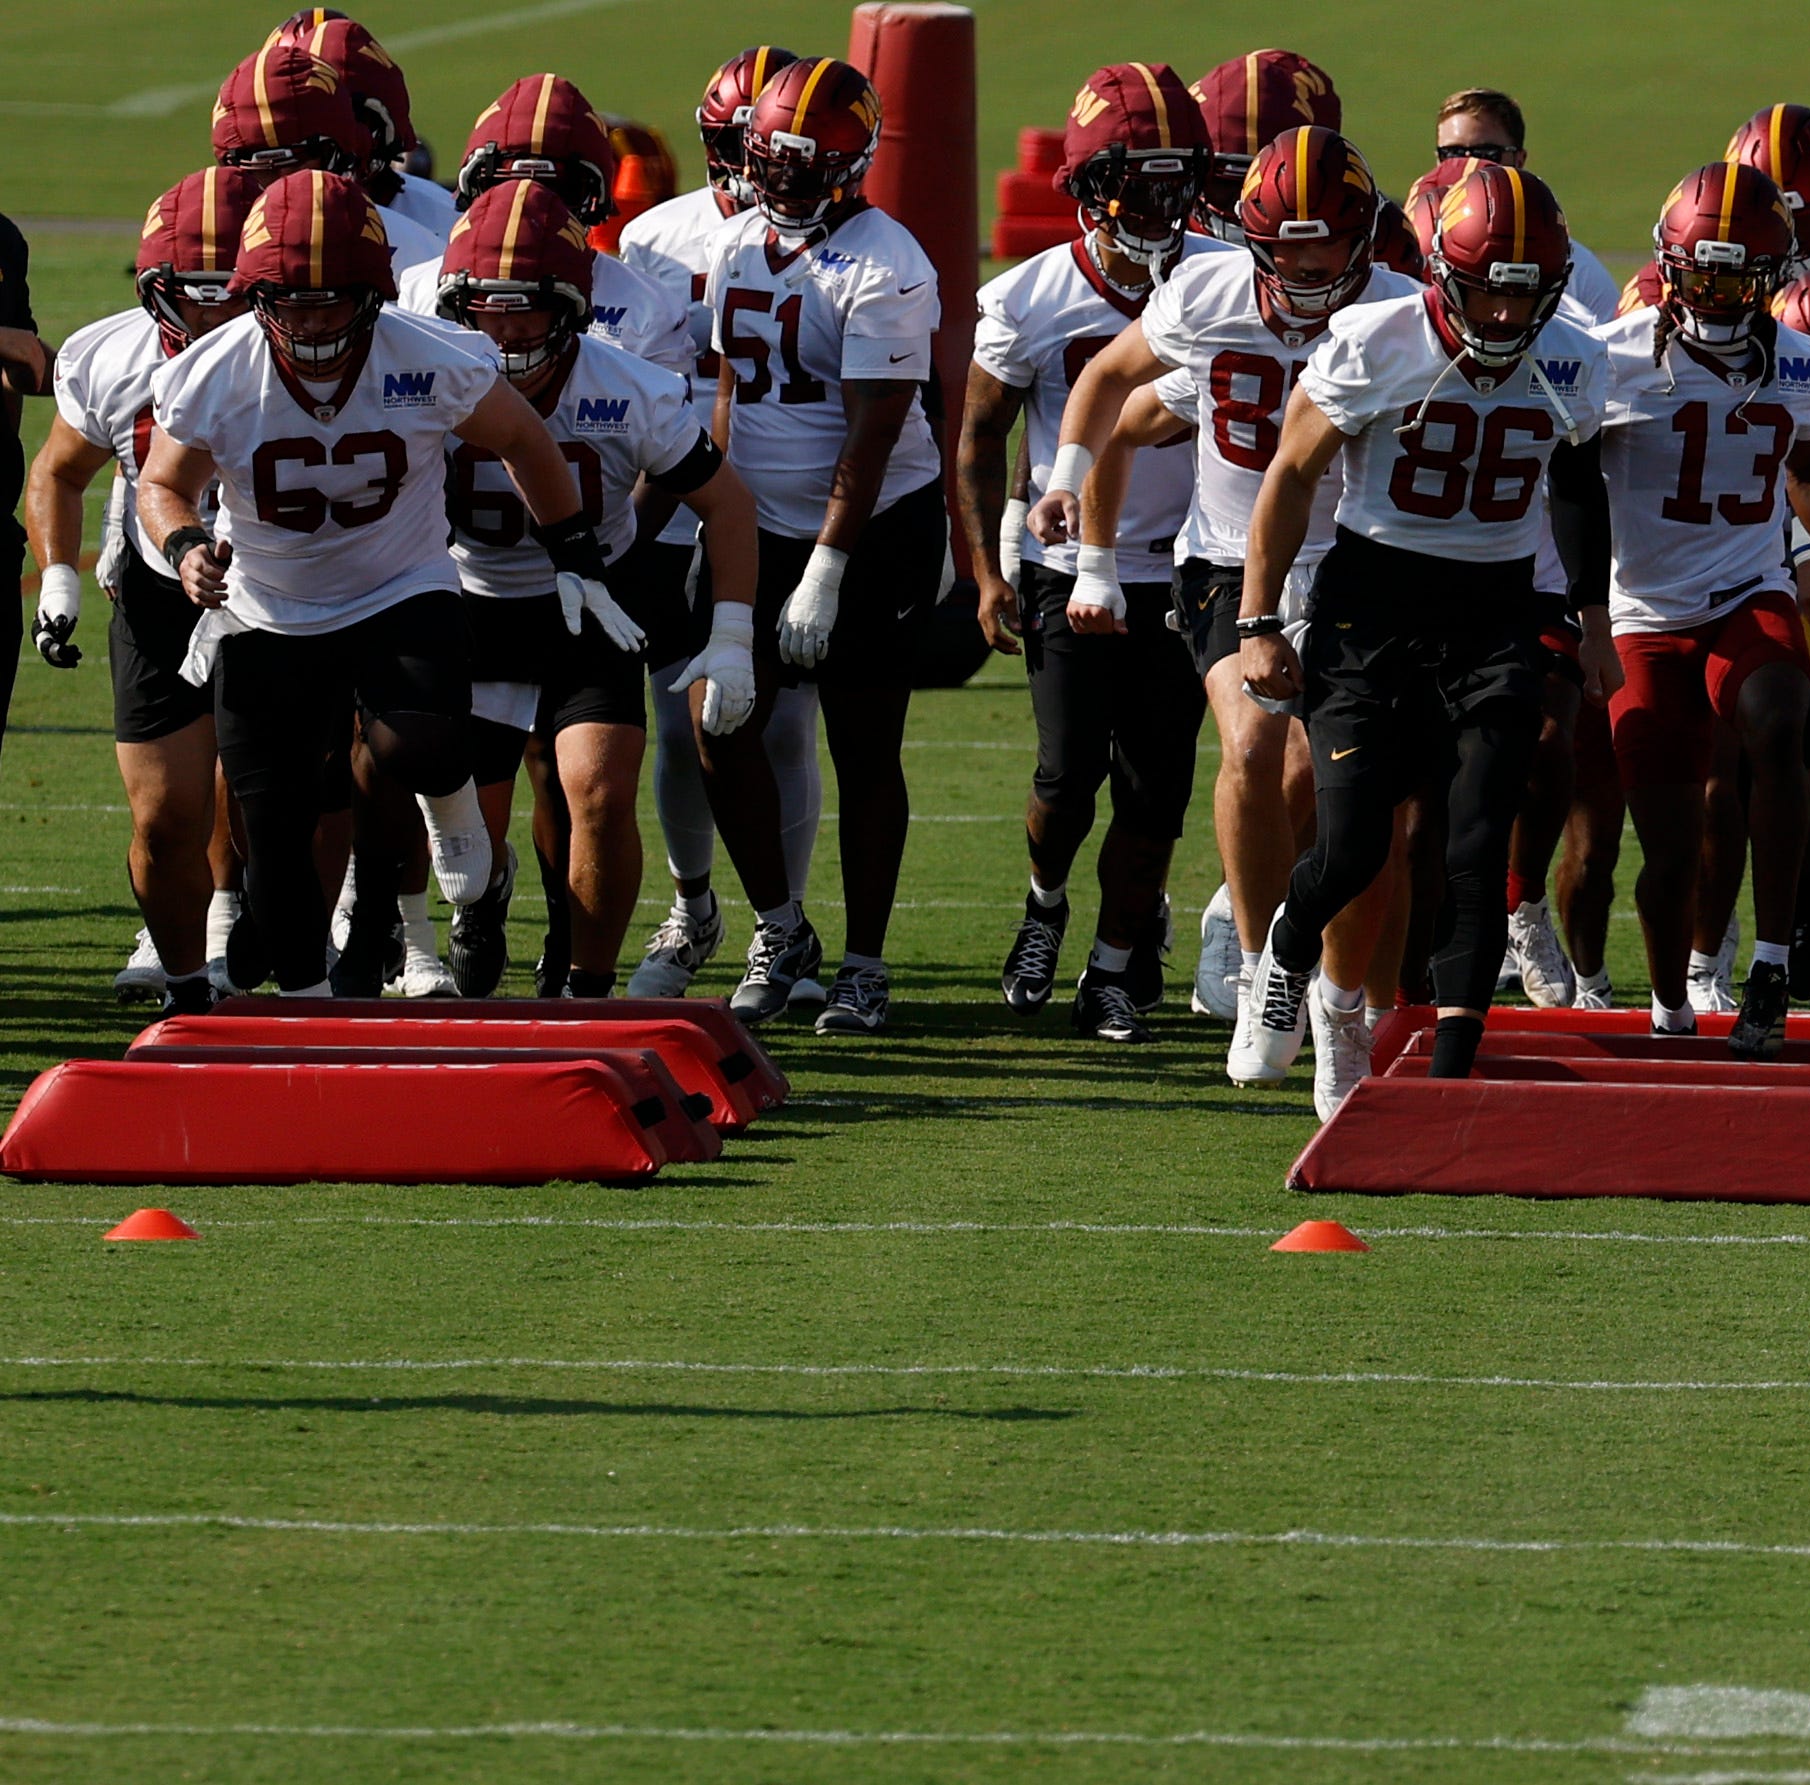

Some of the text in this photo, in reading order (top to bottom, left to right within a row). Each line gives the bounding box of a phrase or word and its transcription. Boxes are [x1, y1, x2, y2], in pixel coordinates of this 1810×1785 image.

[594, 305, 628, 325] W
[722, 288, 826, 404] 51
[383, 372, 436, 397] NW
[1530, 383, 1579, 393] NOWEST
[383, 396, 437, 405] NORTHWEST
[576, 398, 630, 421] NW
[1210, 350, 1310, 473] 8
[576, 422, 630, 430] NORTHWEST
[1388, 401, 1554, 522] 86
[1662, 401, 1795, 526] 13
[252, 430, 409, 533] 63
